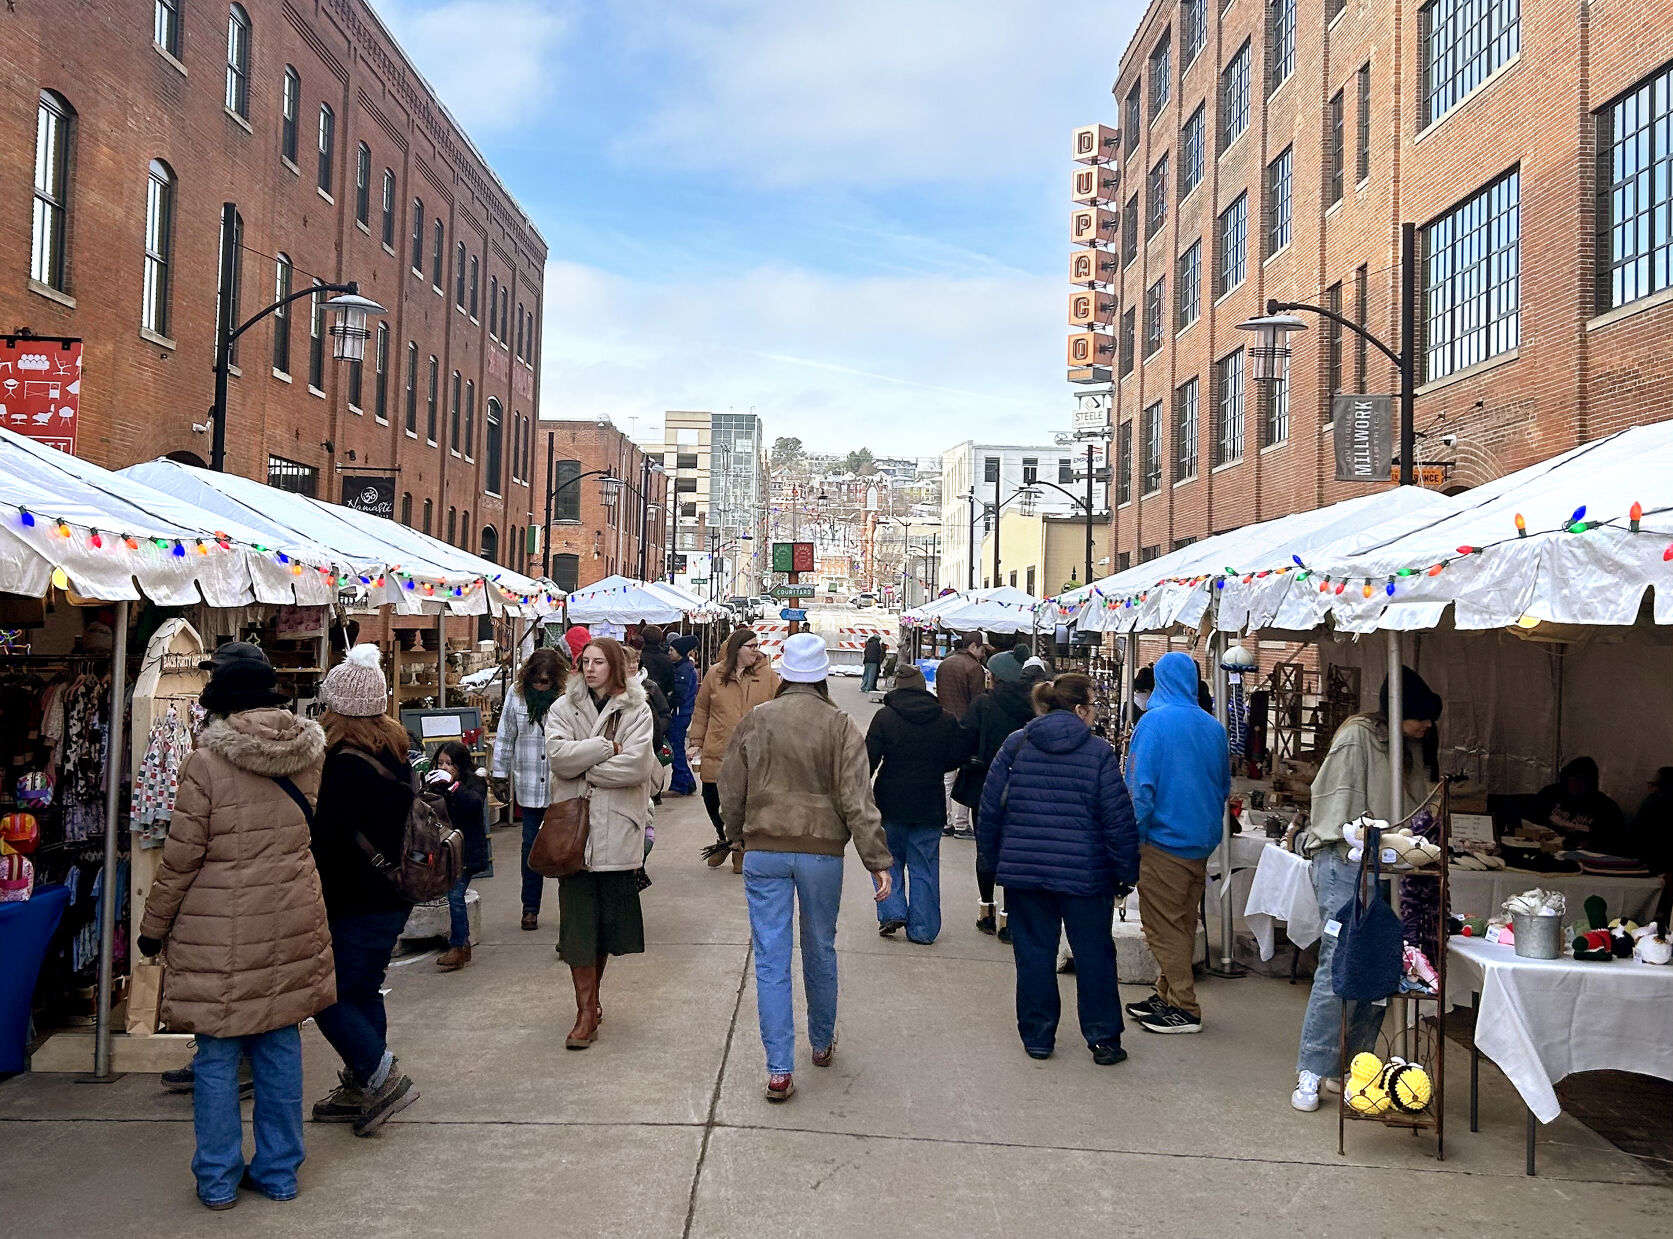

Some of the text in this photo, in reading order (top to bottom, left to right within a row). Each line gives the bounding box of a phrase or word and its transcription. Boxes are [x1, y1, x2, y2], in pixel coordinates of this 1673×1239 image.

[1073, 130, 1094, 360] DUPACO
[1075, 410, 1104, 422] STEELE
[1354, 401, 1373, 476] MILLWORK
[776, 588, 812, 596] COURTYARD
